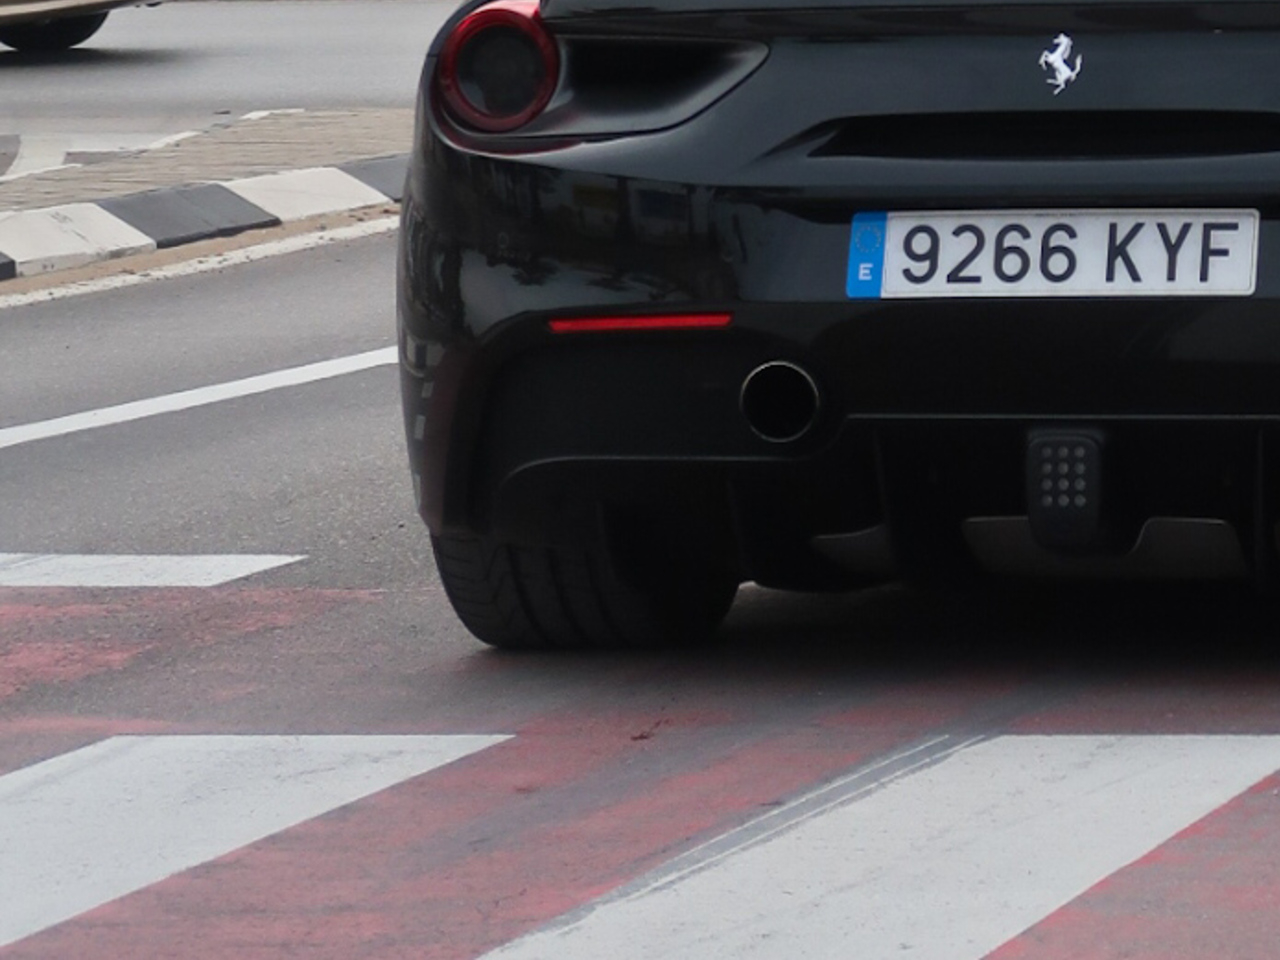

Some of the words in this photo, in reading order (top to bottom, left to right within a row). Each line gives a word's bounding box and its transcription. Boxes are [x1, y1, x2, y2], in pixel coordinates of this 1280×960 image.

[859, 263, 873, 280] E
[902, 223, 1078, 284] 9266
[1105, 221, 1239, 283] KYF
